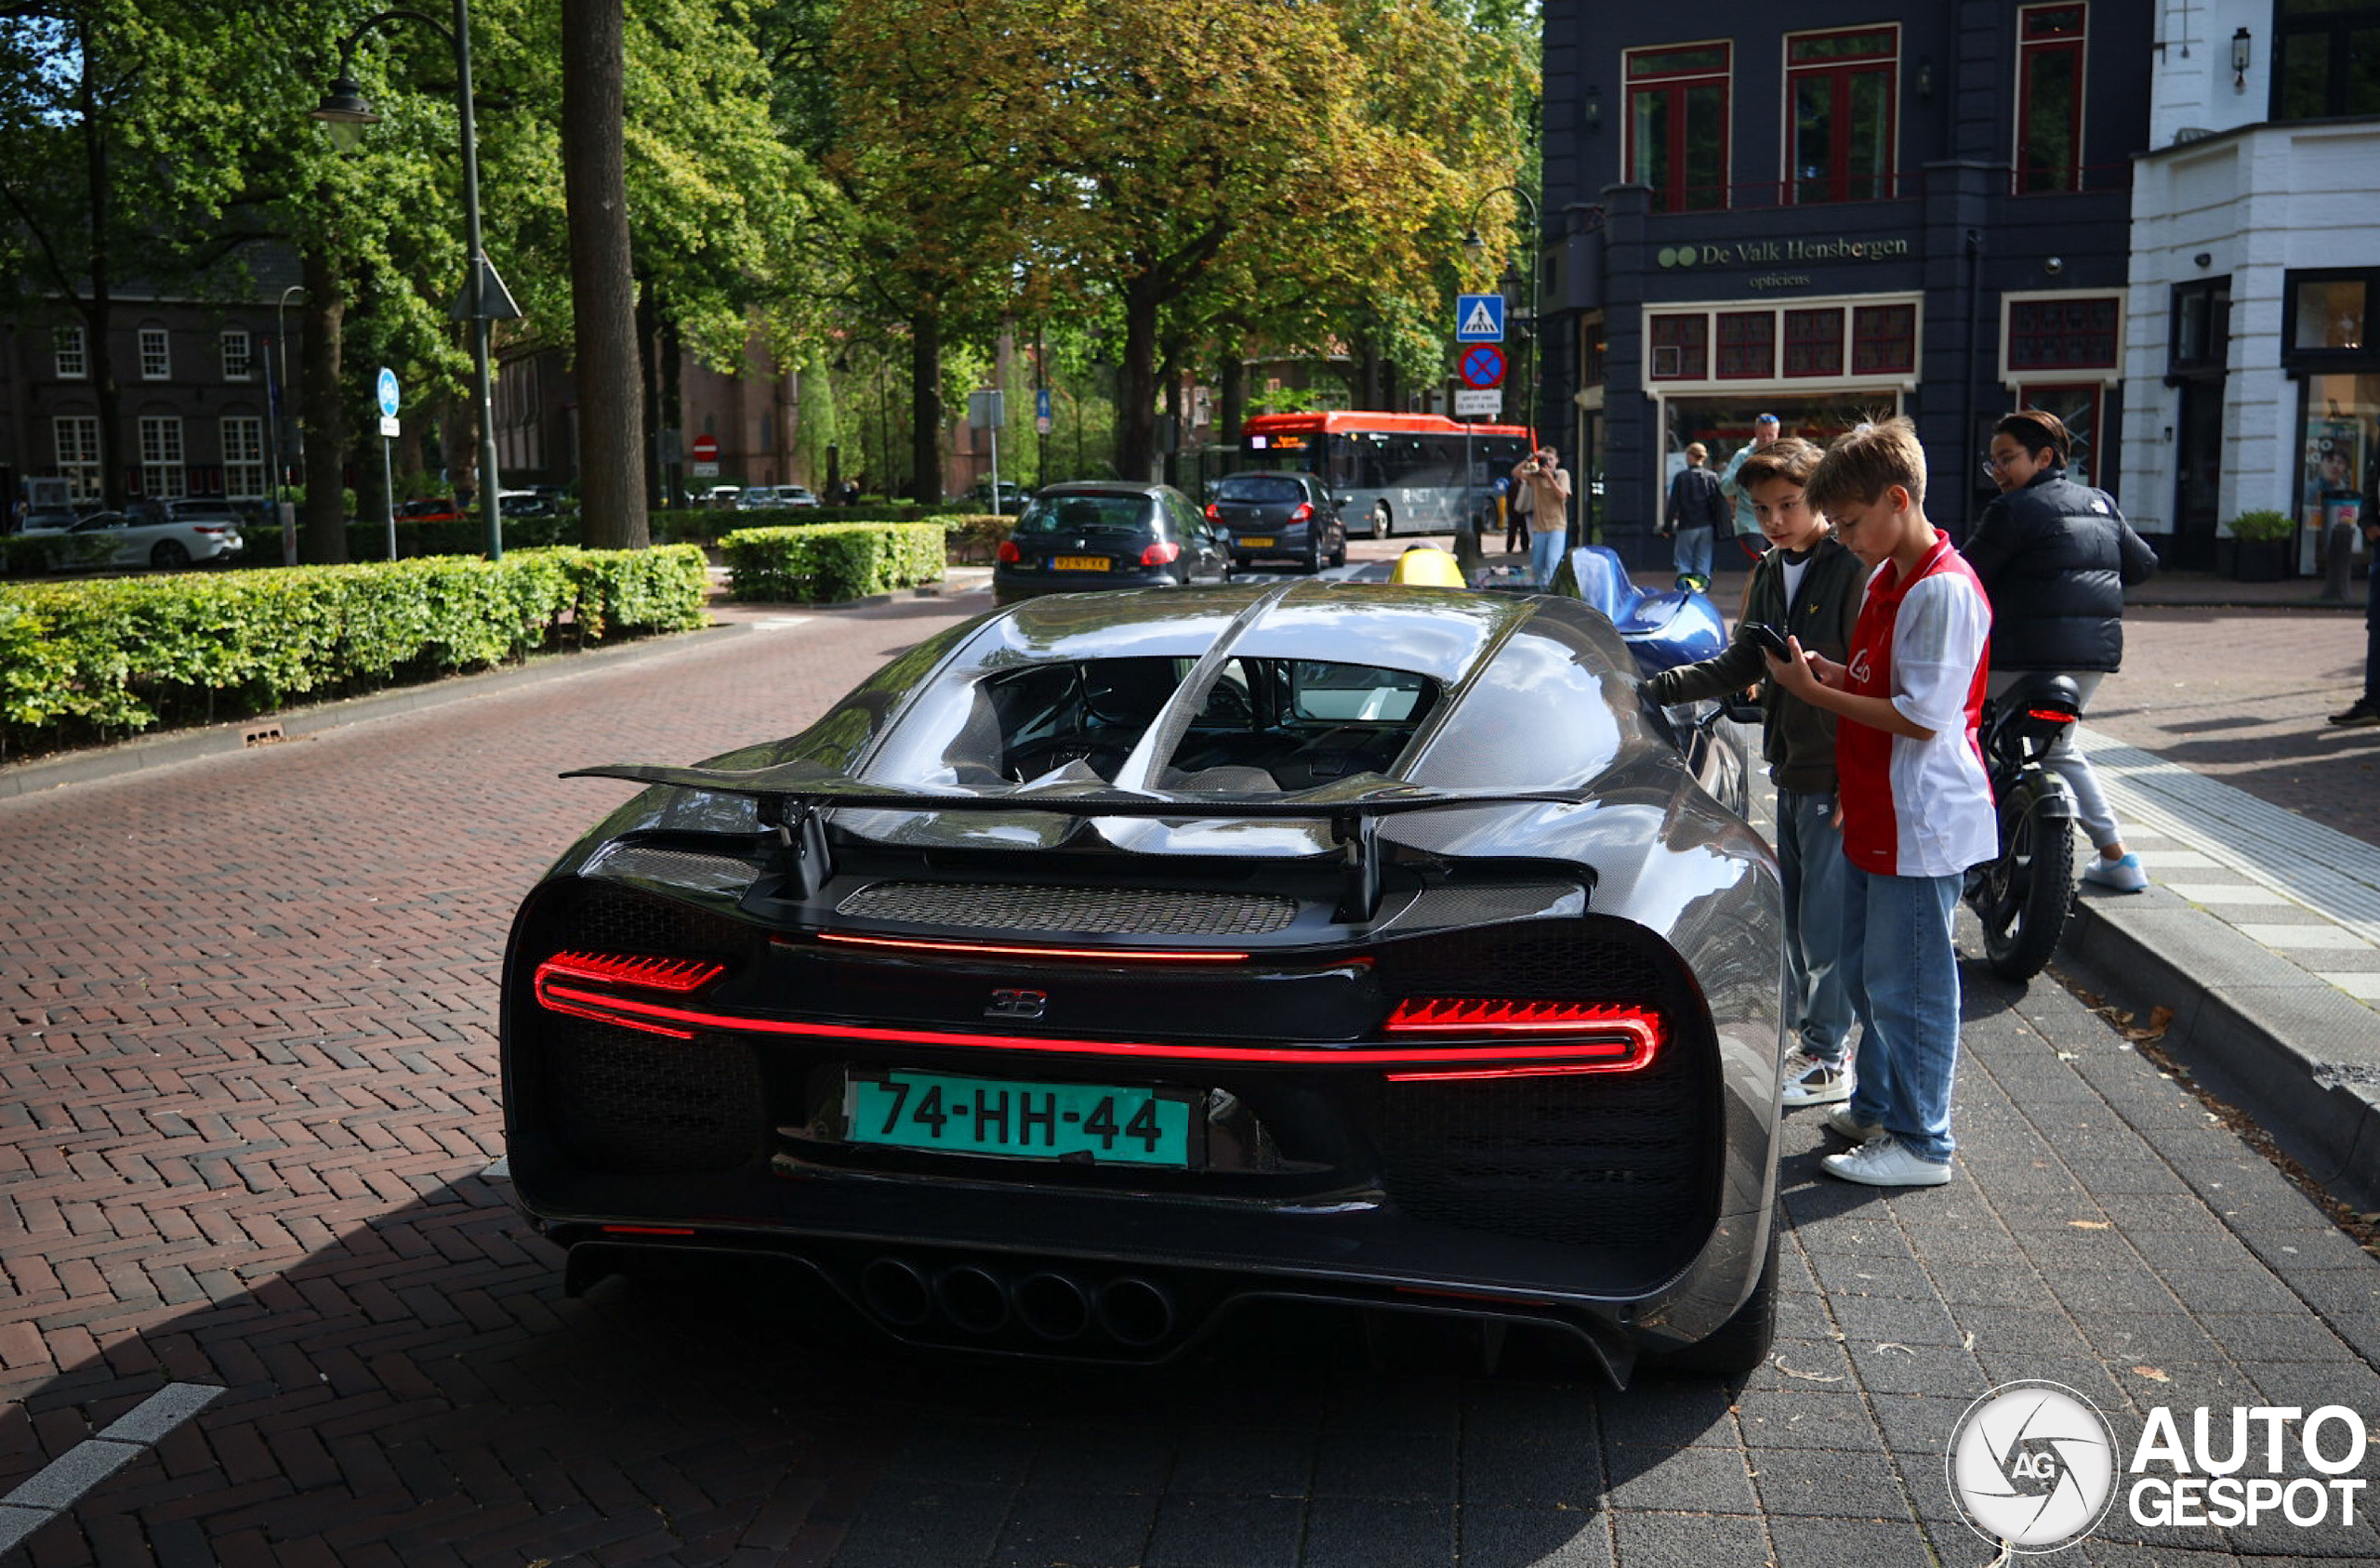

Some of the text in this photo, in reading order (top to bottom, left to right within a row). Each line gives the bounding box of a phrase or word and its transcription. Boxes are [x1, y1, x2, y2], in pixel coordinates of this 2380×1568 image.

[1702, 238, 1908, 265] De Valk Hensbergen
[1749, 273, 1812, 290] opticiens
[879, 1081, 1162, 1153] 74-HH-44
